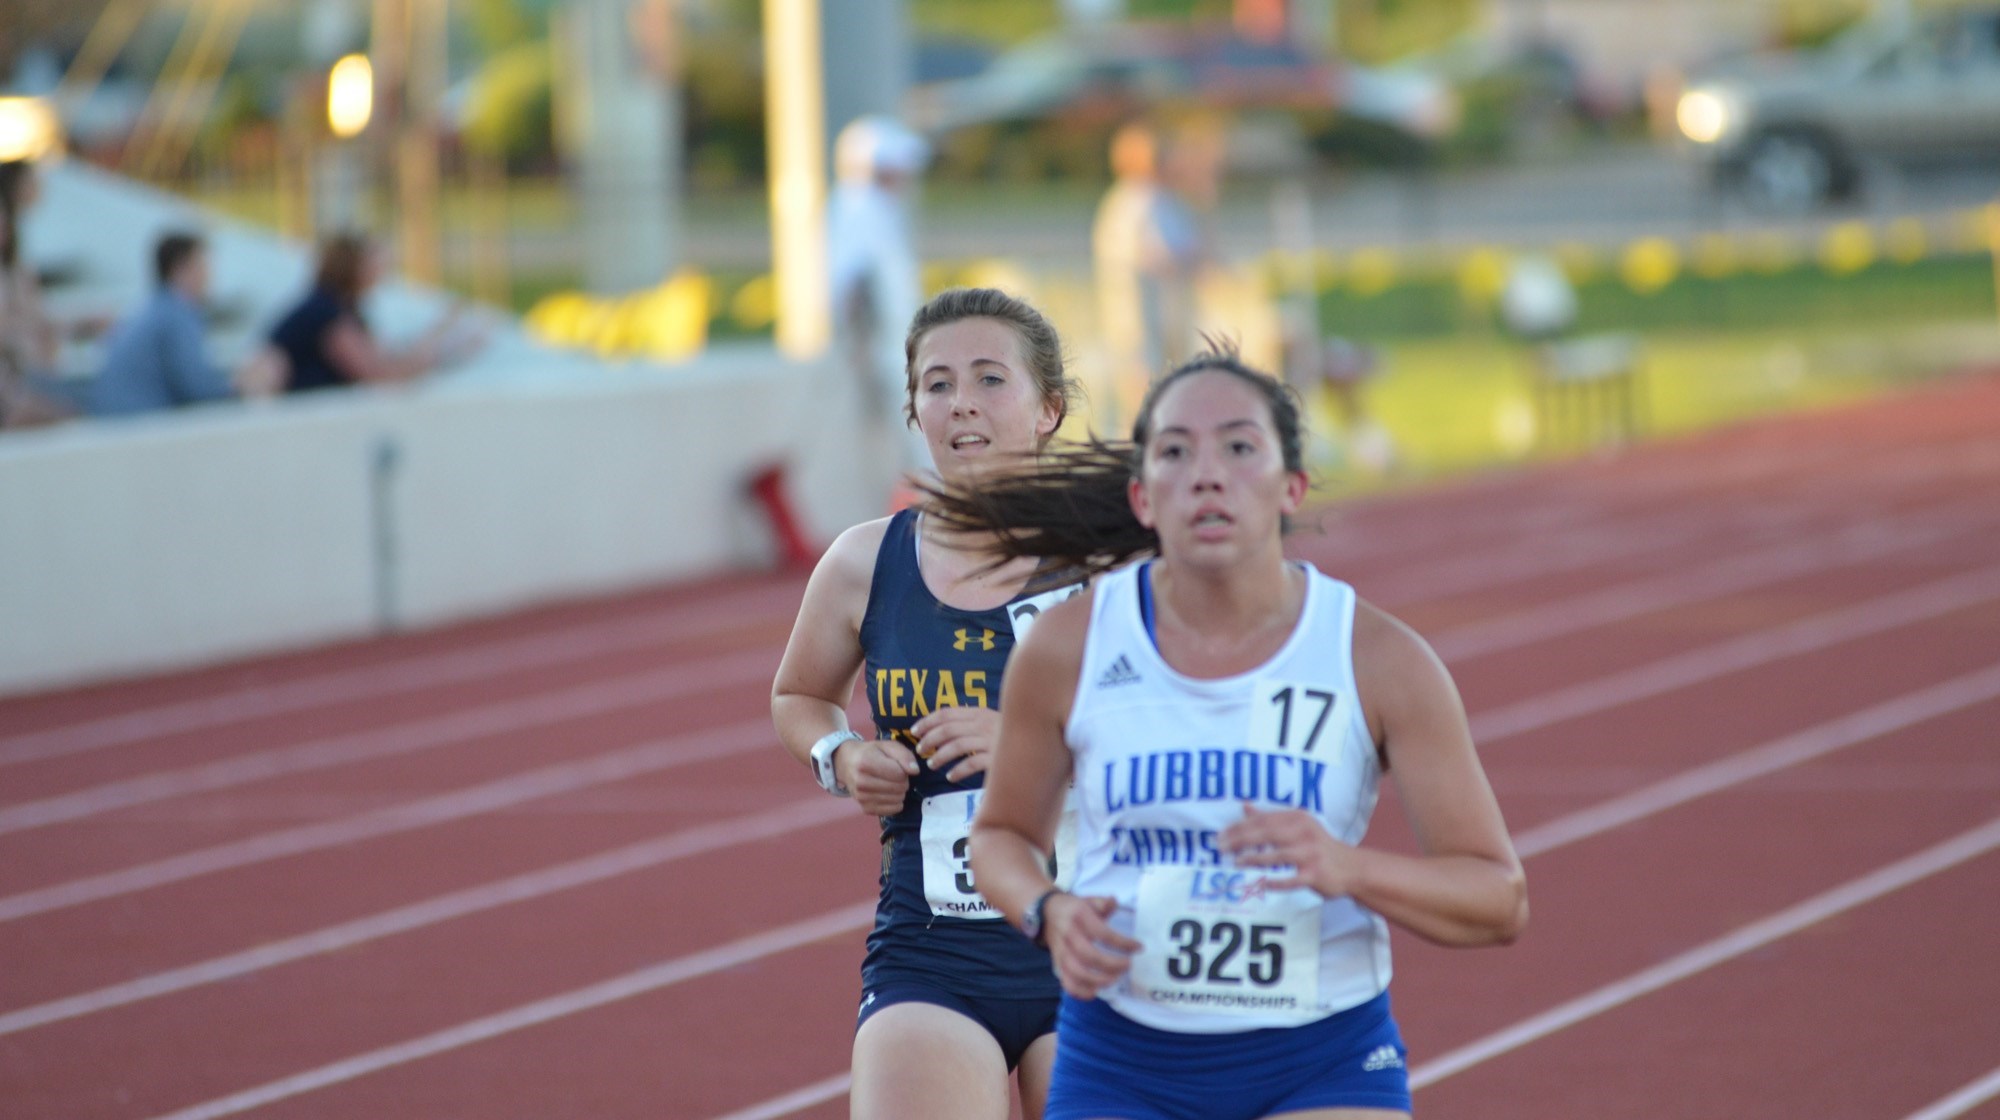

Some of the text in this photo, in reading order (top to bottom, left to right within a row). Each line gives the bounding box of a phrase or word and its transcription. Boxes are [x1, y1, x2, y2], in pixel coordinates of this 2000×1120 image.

[876, 668, 988, 717] TEXAS
[1271, 687, 1336, 752] 17
[1104, 750, 1327, 815] LUBBOCK
[1168, 919, 1286, 988] 325
[1151, 990, 1297, 1010] CHAMPIONSHIPS
